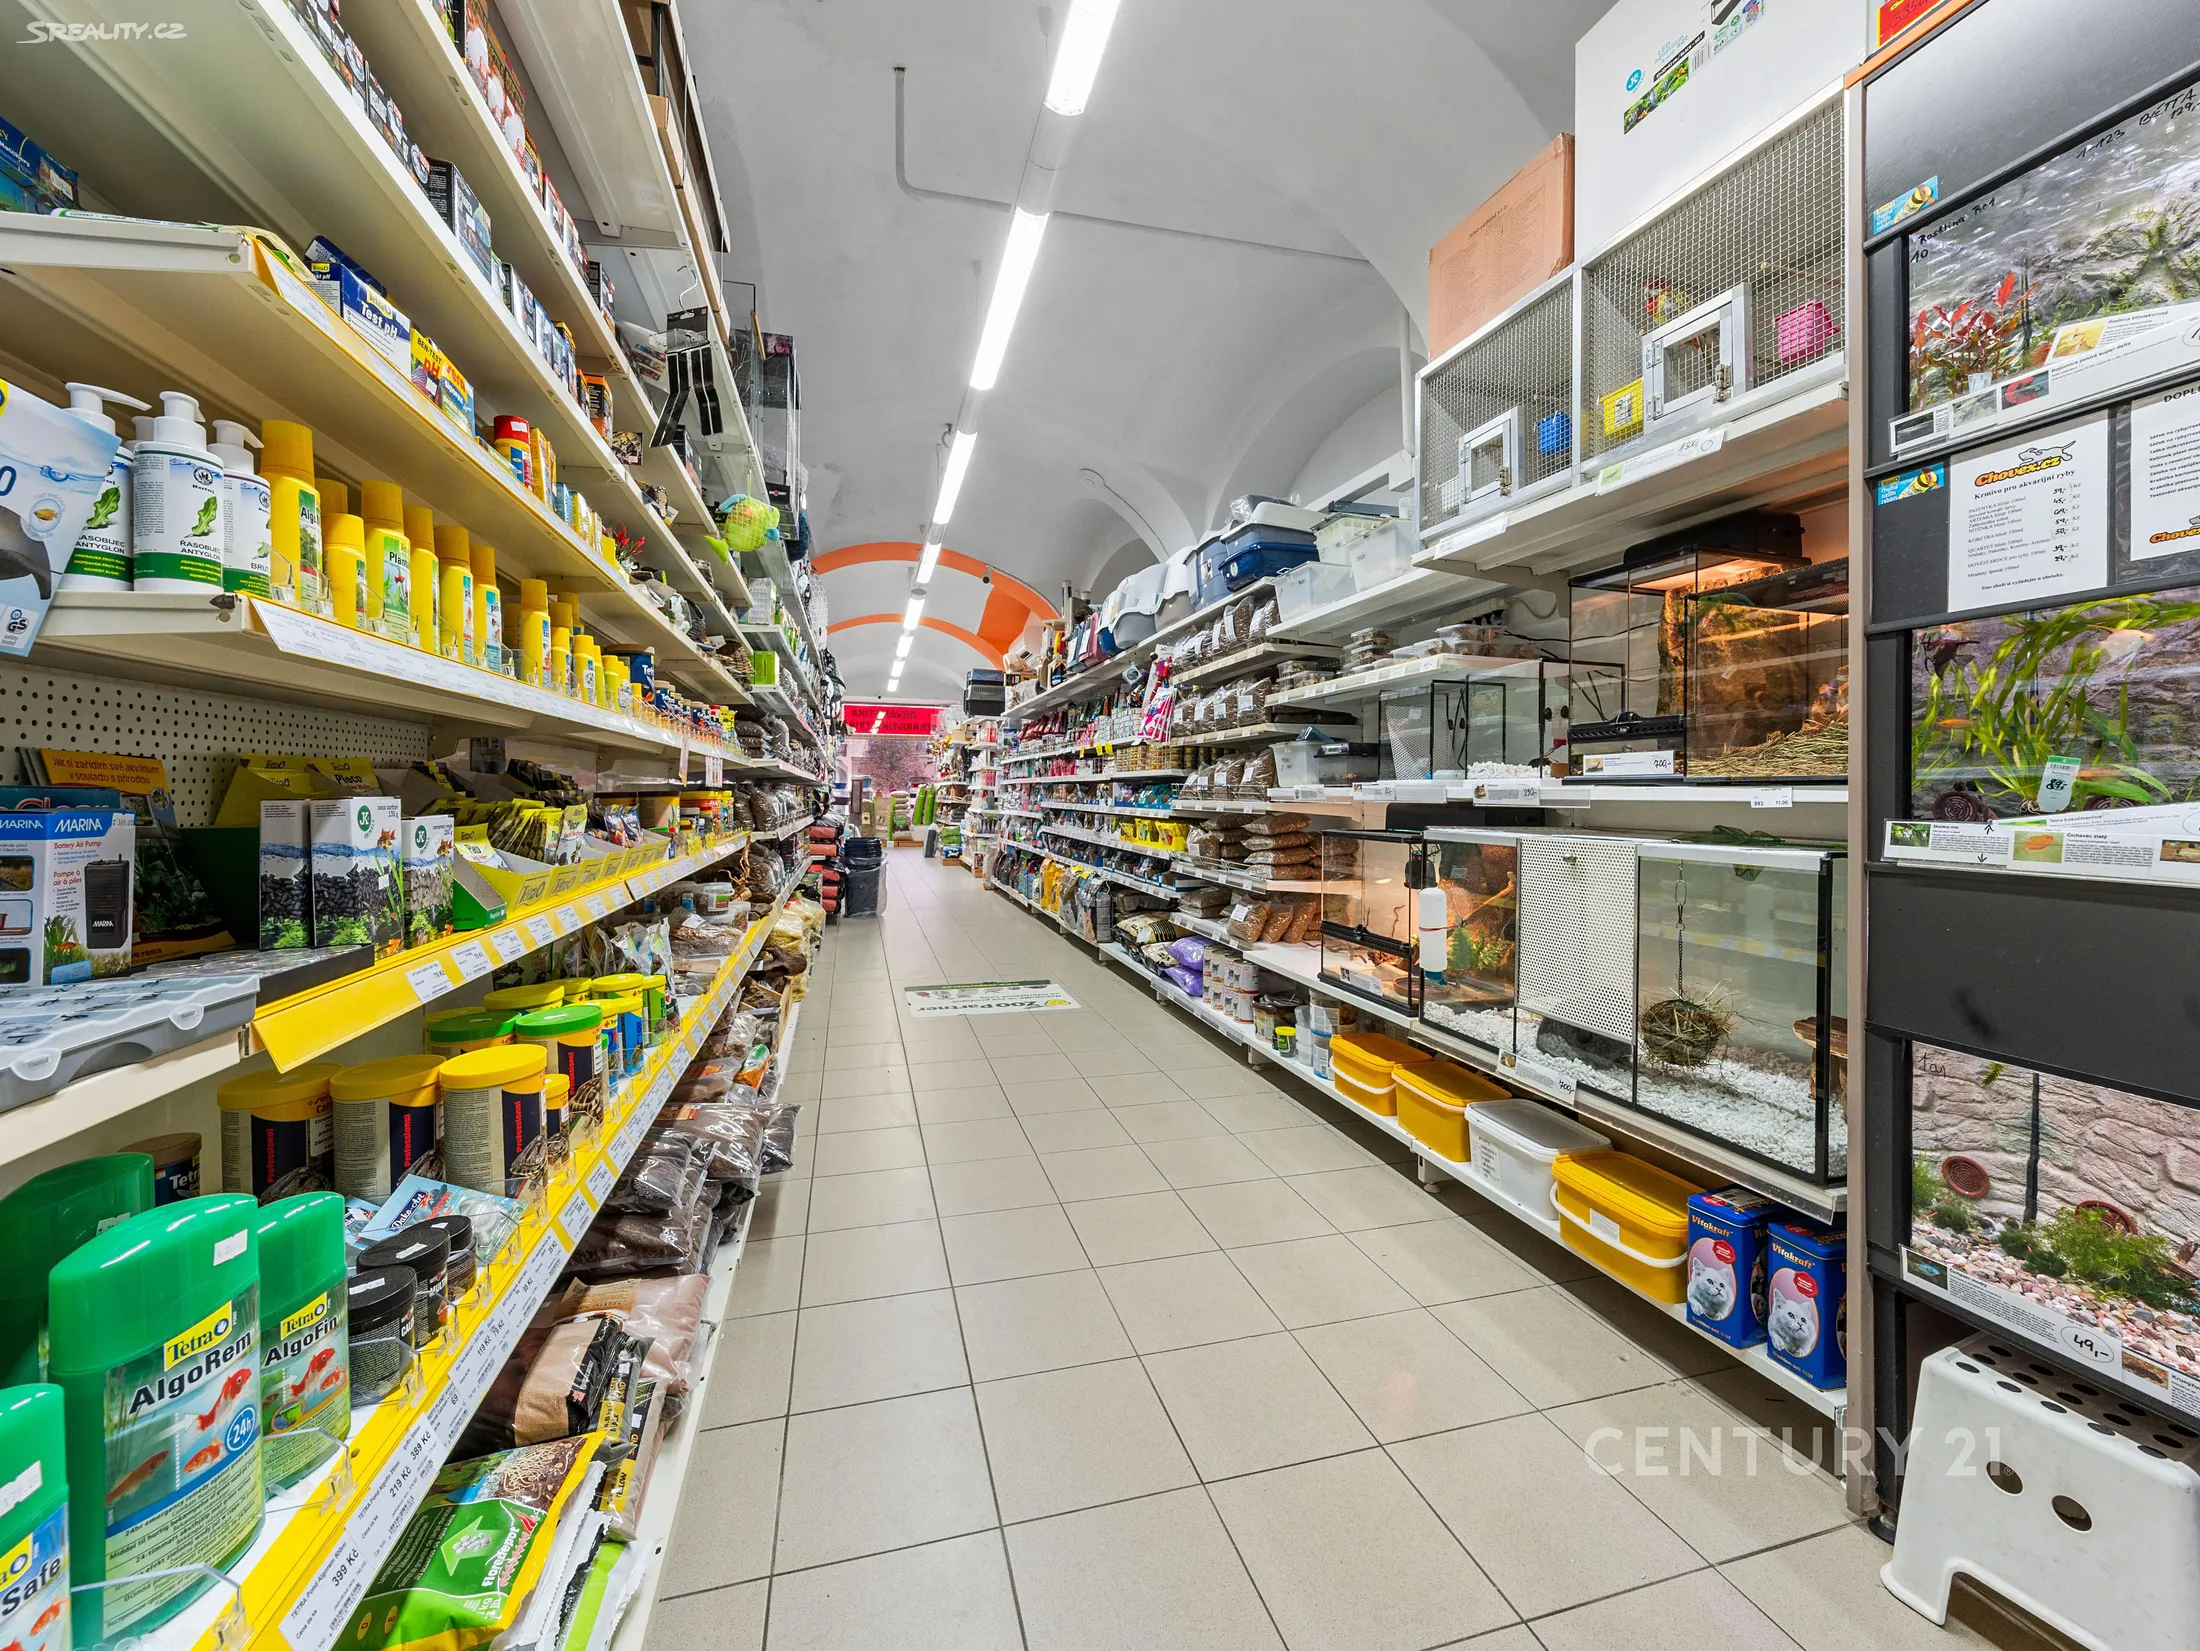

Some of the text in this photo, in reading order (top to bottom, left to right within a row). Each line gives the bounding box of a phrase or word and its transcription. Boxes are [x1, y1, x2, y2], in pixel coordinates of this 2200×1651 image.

[2139, 88, 2196, 126] BETTA
[361, 302, 384, 329] Test
[384, 319, 399, 341] pH
[416, 337, 442, 365] BEN-TEST
[423, 357, 441, 380] pH
[1974, 455, 2061, 487] Chovex.cz
[1974, 470, 2076, 500] Krmivo pro akvarijní ryby
[75, 541, 125, 555] ANTYGLON
[78, 534, 125, 548] ASOBIJEC
[181, 547, 221, 561] ANTYGLON
[75, 770, 109, 782] souladu
[109, 761, 124, 772] své
[125, 762, 160, 775] akvárium
[336, 774, 362, 784] Pleco
[54, 817, 103, 833] MARINA
[76, 841, 84, 849] Air
[85, 840, 102, 850] Pump
[53, 870, 75, 880] Pompe
[53, 876, 82, 887] air piles
[92, 920, 114, 928] MARINA
[403, 1113, 412, 1168] Professional
[515, 1101, 523, 1153] Professional
[1691, 1214, 1731, 1238] Vitakraft
[1772, 1243, 1813, 1270] Vitakraft
[283, 1312, 314, 1334] Tetra
[167, 1330, 213, 1362] Tetra
[265, 1317, 337, 1367] AlgoFin
[2073, 1333, 2109, 1359] 49,-
[129, 1331, 251, 1415] AlgoRem
[232, 1417, 253, 1444] 24h
[410, 1430, 431, 1460] 389 Kč
[389, 1465, 412, 1498] 219 Kč
[331, 1548, 360, 1587] 399 Kč
[482, 1527, 520, 1588] floredepot
[1, 1555, 62, 1617] Safe
[291, 1601, 307, 1619] TETRA
